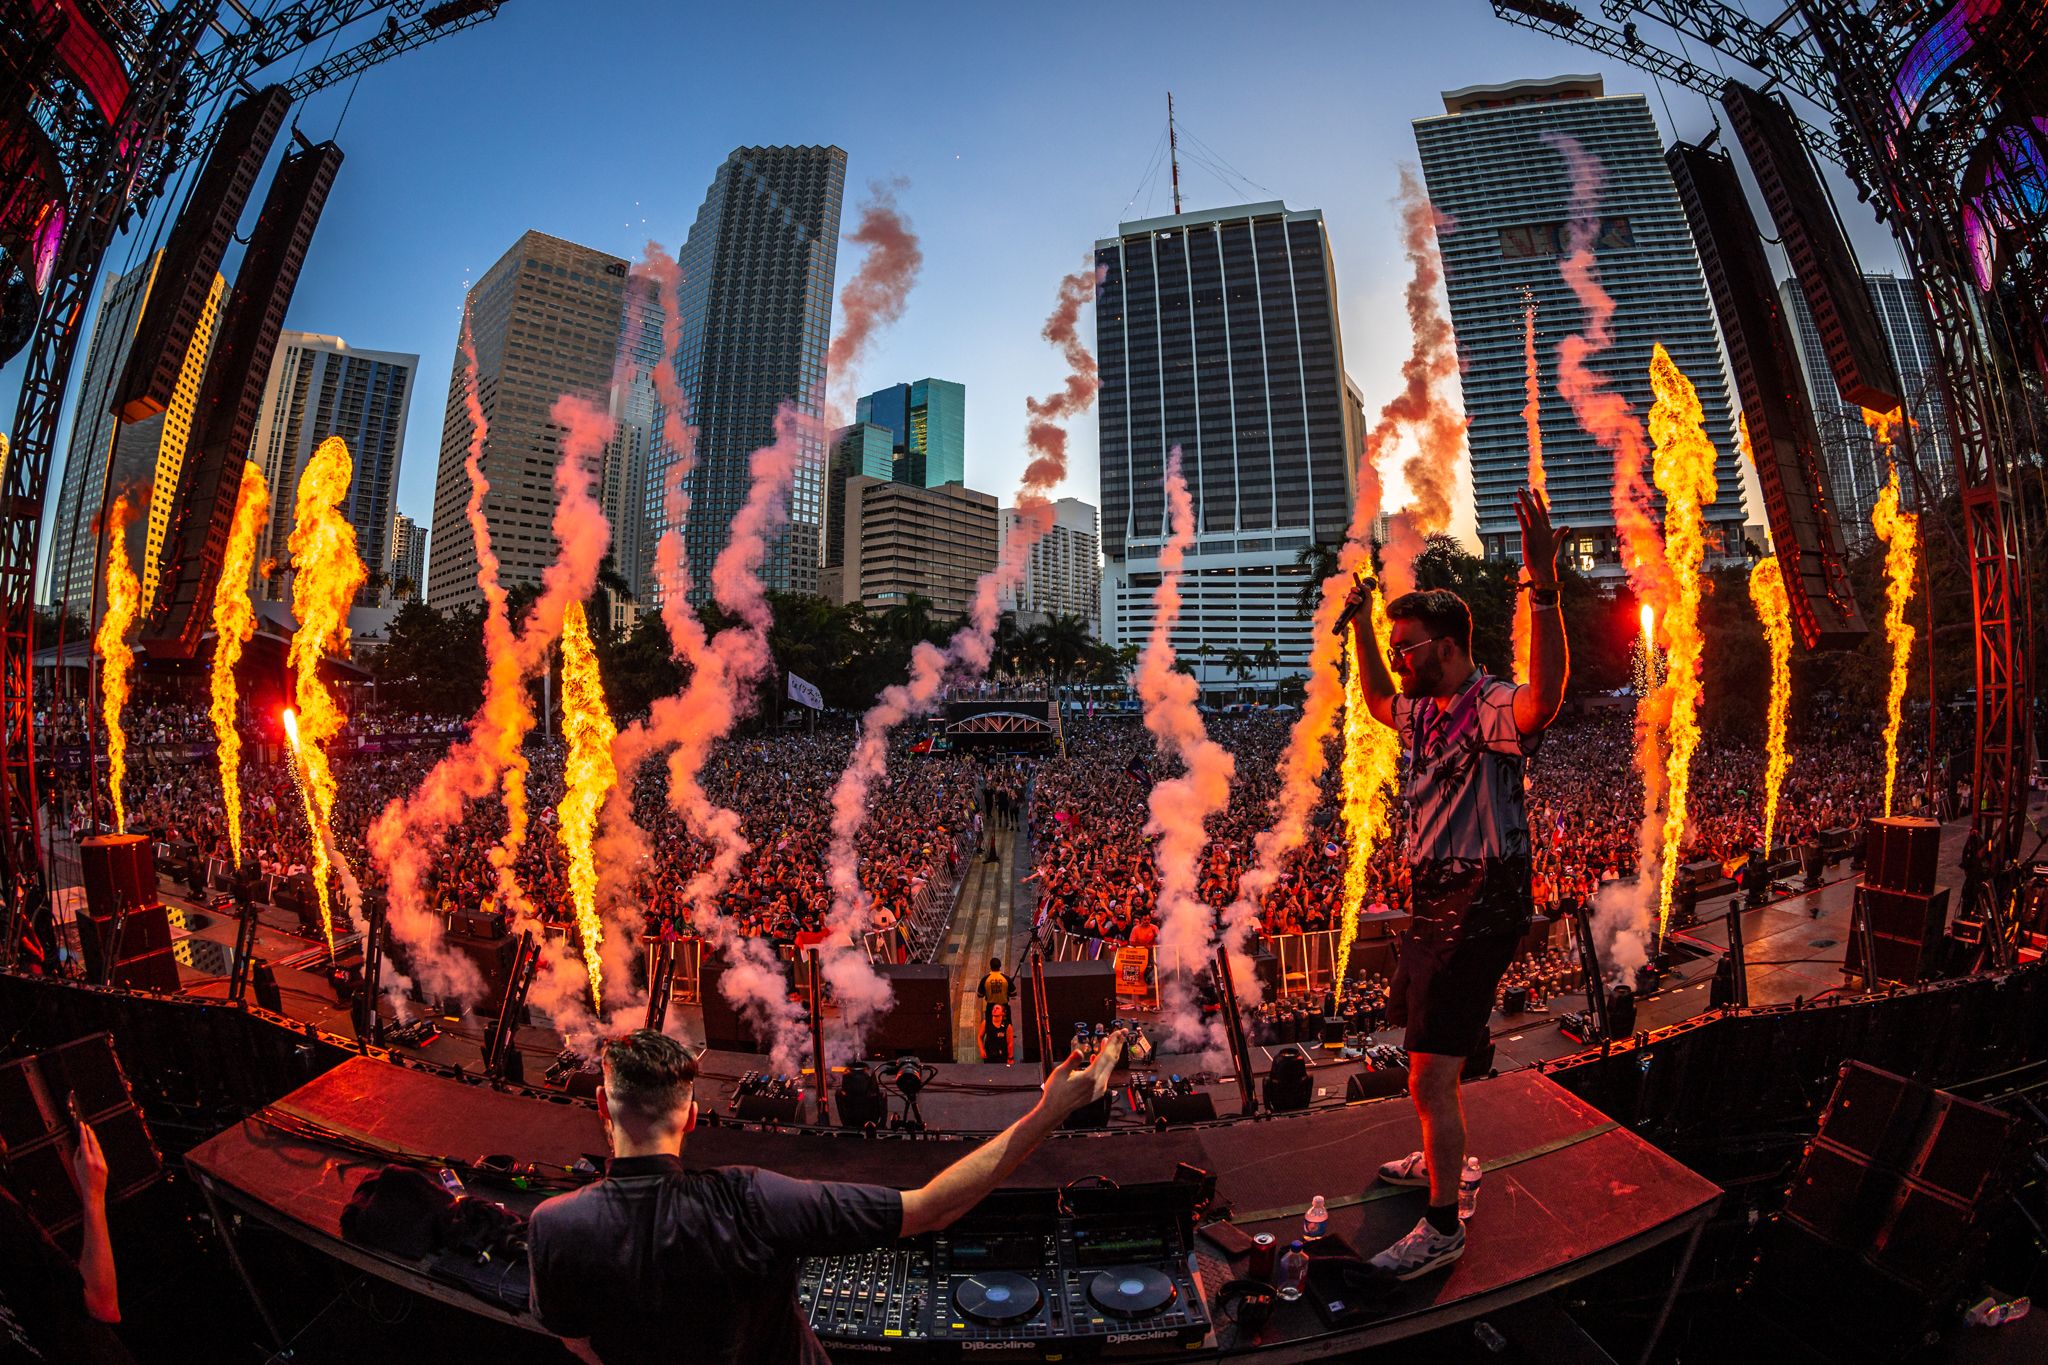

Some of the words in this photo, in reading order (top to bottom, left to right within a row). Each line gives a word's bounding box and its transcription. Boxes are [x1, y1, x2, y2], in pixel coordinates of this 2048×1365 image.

[606, 263, 626, 277] citi
[1106, 1329, 1180, 1344] DjBackline
[822, 1340, 892, 1353] DjBackline
[961, 1340, 1037, 1351] DjBackline
